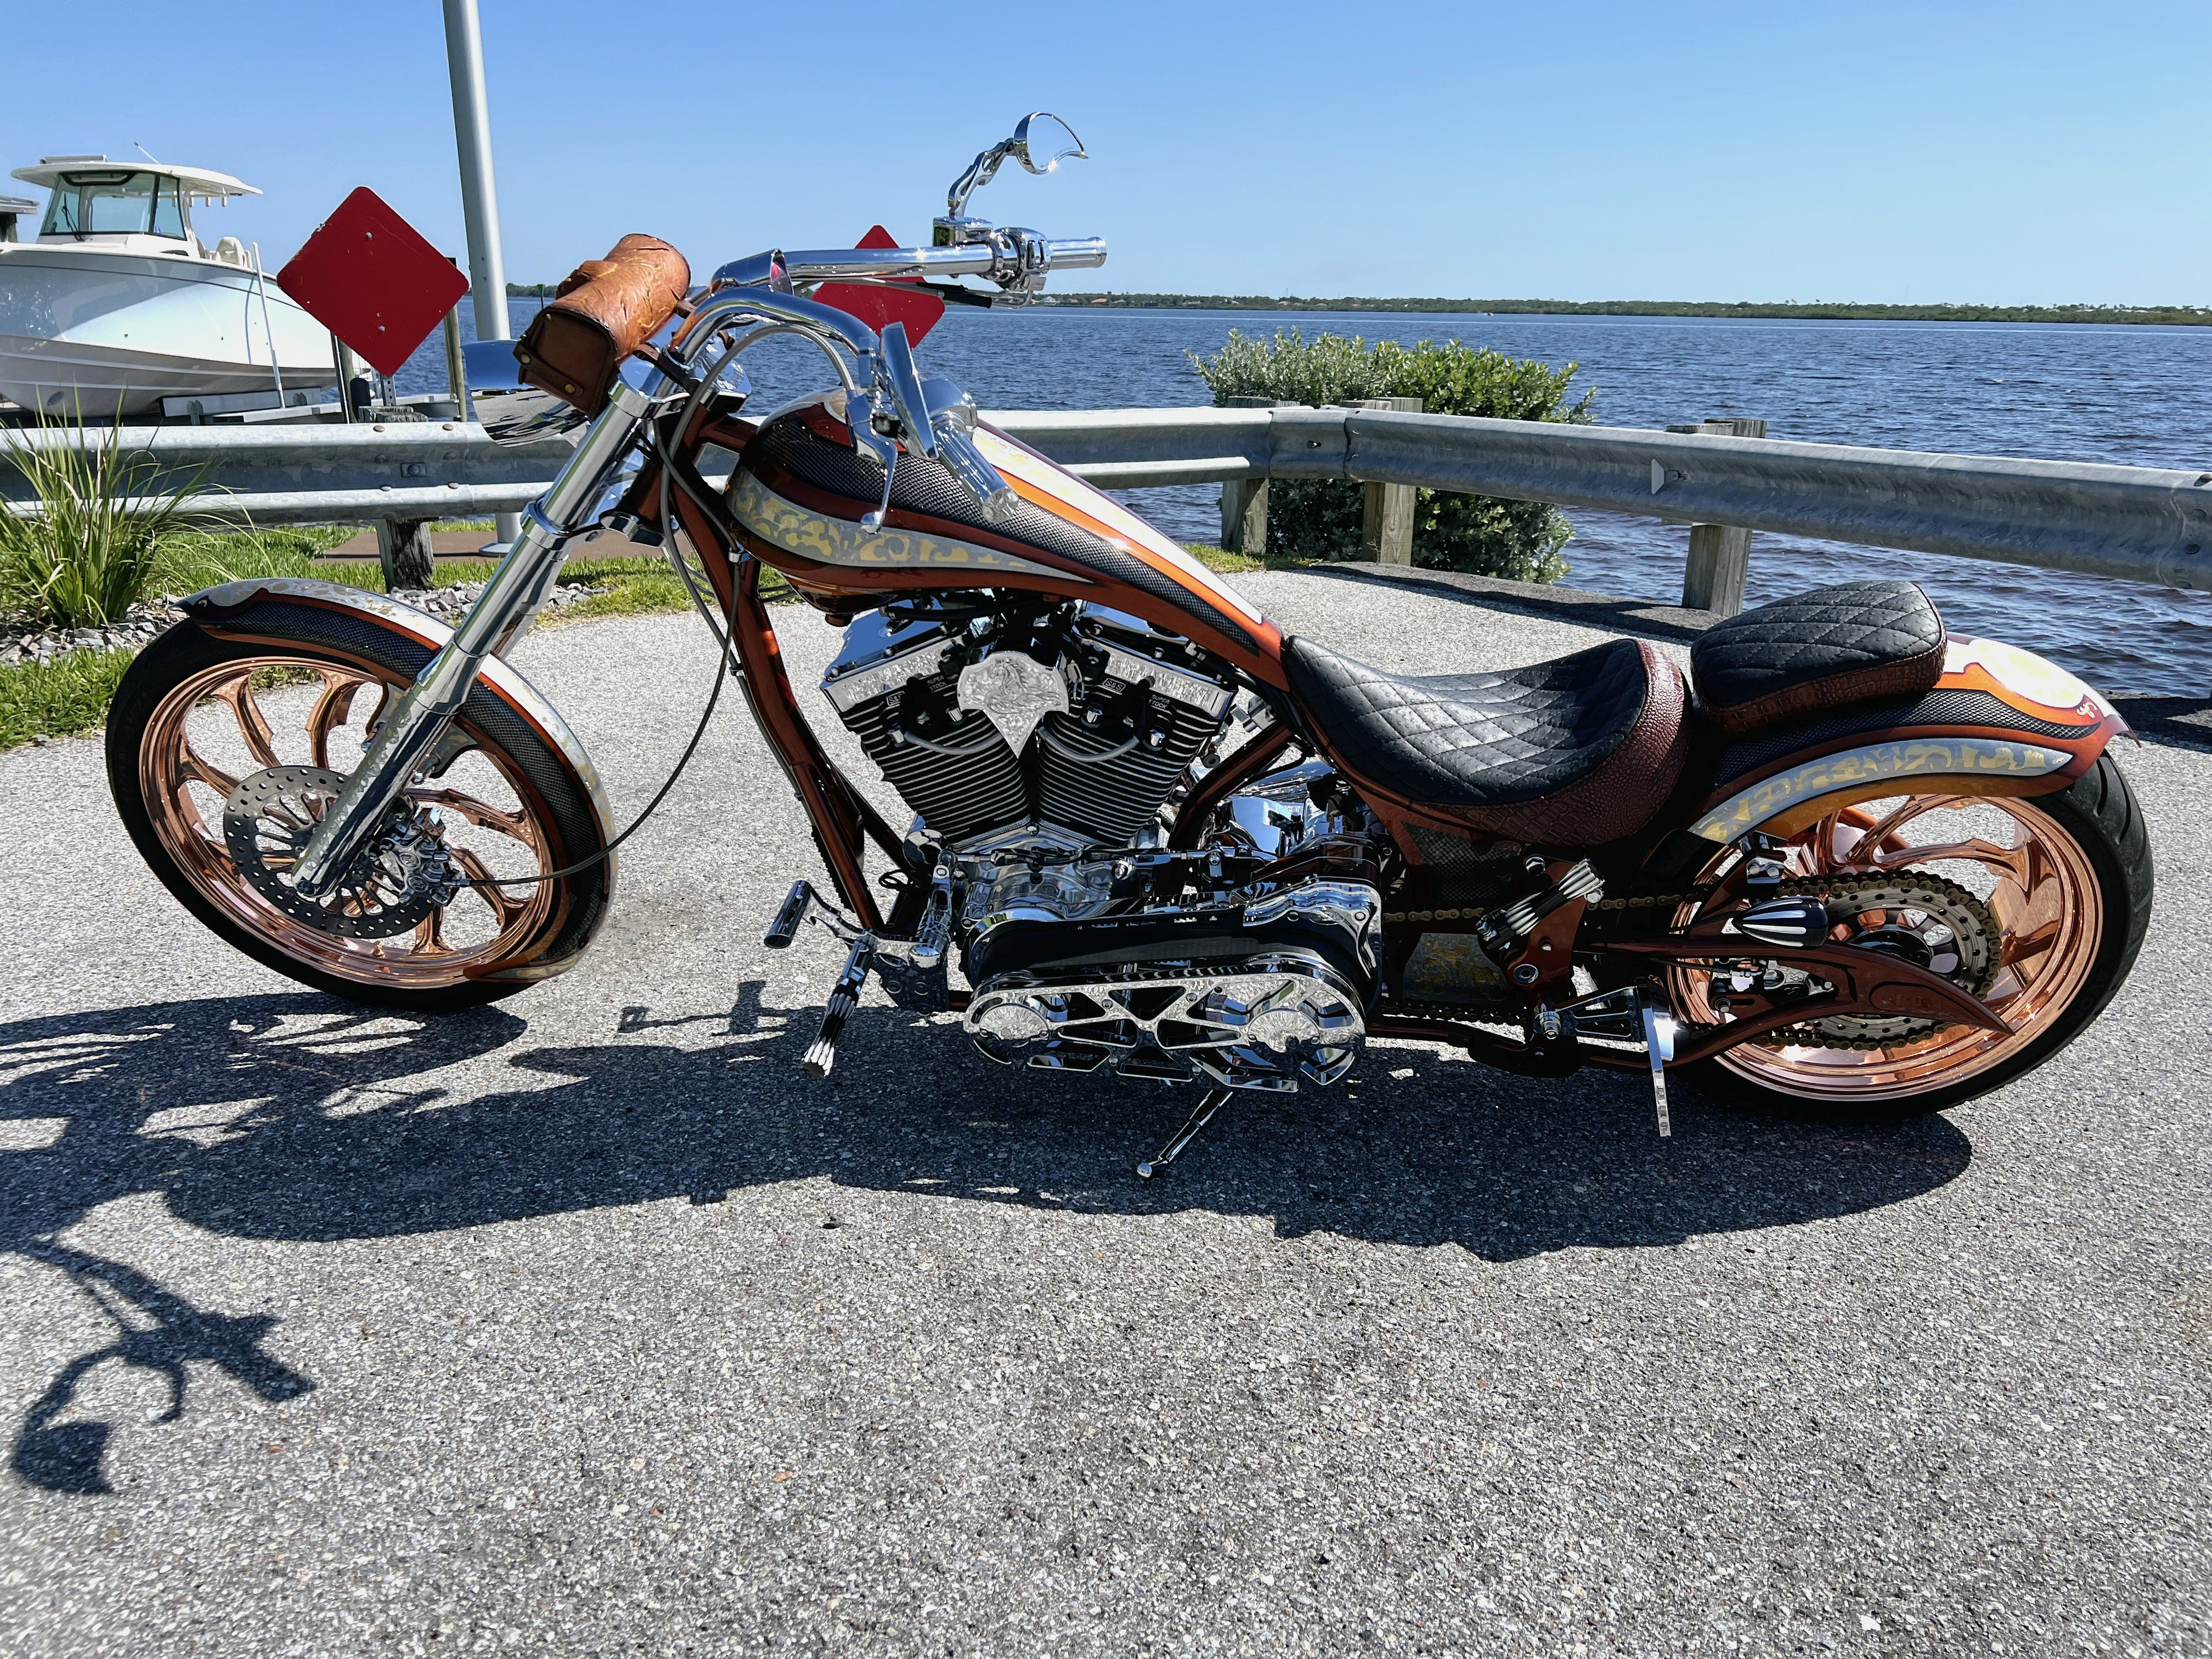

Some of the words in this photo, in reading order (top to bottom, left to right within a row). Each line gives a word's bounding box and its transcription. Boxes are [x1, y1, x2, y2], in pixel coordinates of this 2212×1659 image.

[929, 682, 947, 691] STOCK
[1105, 680, 1123, 690] S&S
[1149, 699, 1167, 709] STOCK
[1152, 694, 1170, 704] SUPER
